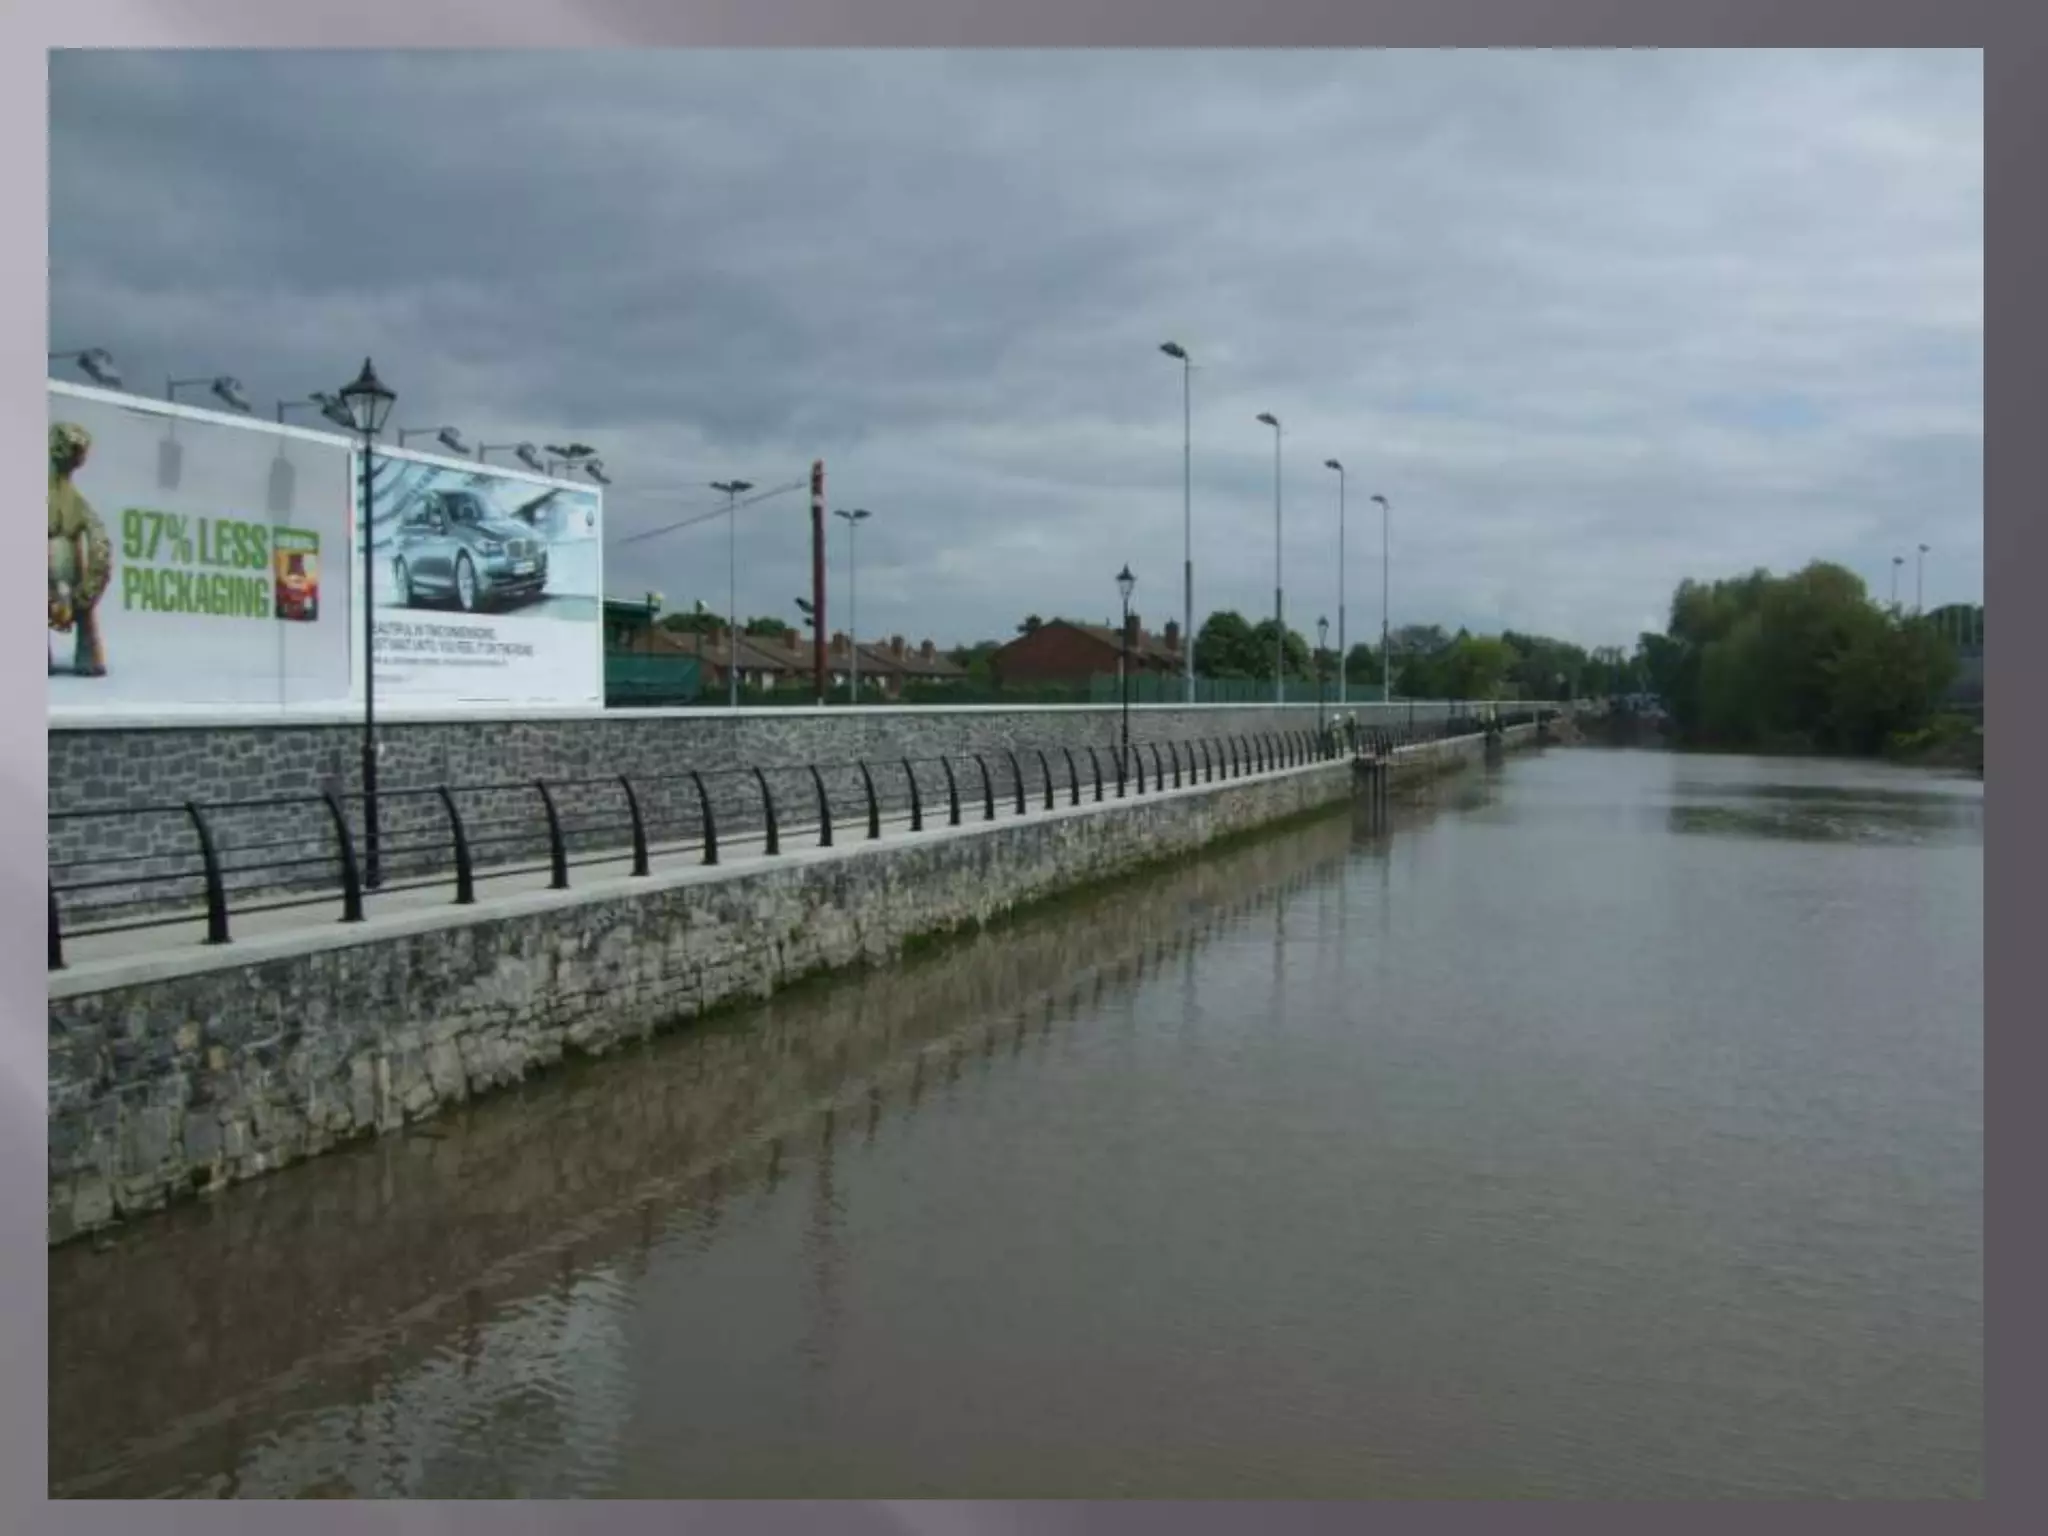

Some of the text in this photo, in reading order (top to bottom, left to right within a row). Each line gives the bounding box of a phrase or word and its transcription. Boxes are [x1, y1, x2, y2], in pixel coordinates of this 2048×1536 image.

[122, 508, 268, 570] 97% LESS
[122, 564, 270, 618] PACKAGING
